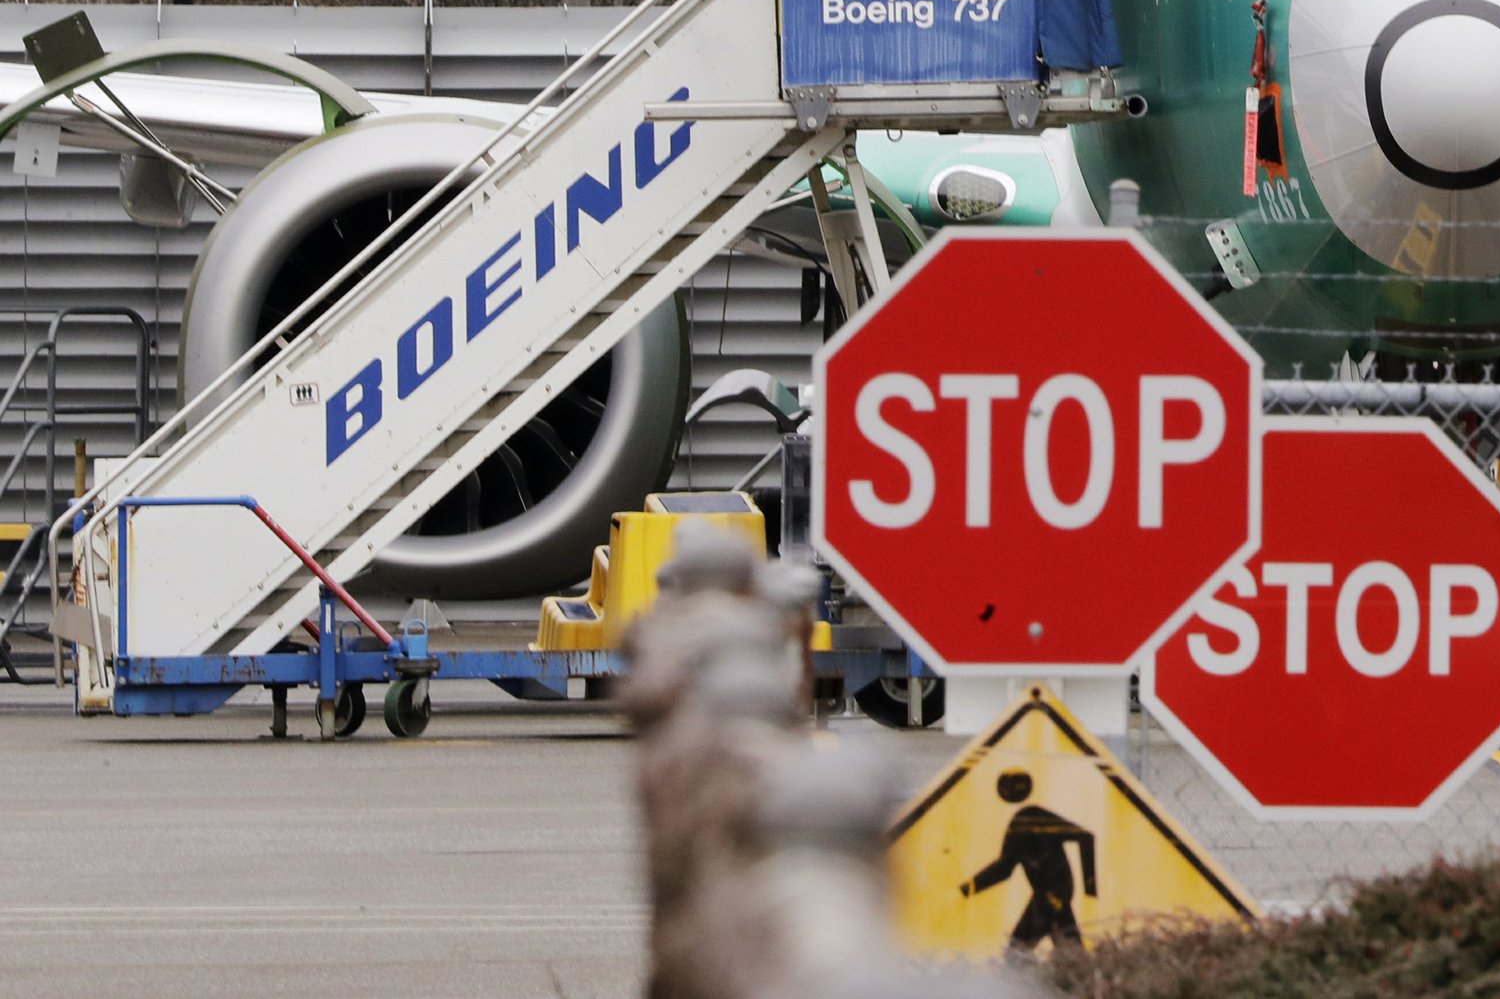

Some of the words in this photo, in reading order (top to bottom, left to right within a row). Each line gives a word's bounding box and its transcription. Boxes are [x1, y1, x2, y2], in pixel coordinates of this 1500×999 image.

[326, 86, 696, 468] BOEING
[847, 372, 1228, 530] STOP
[1186, 560, 1500, 679] STOP
